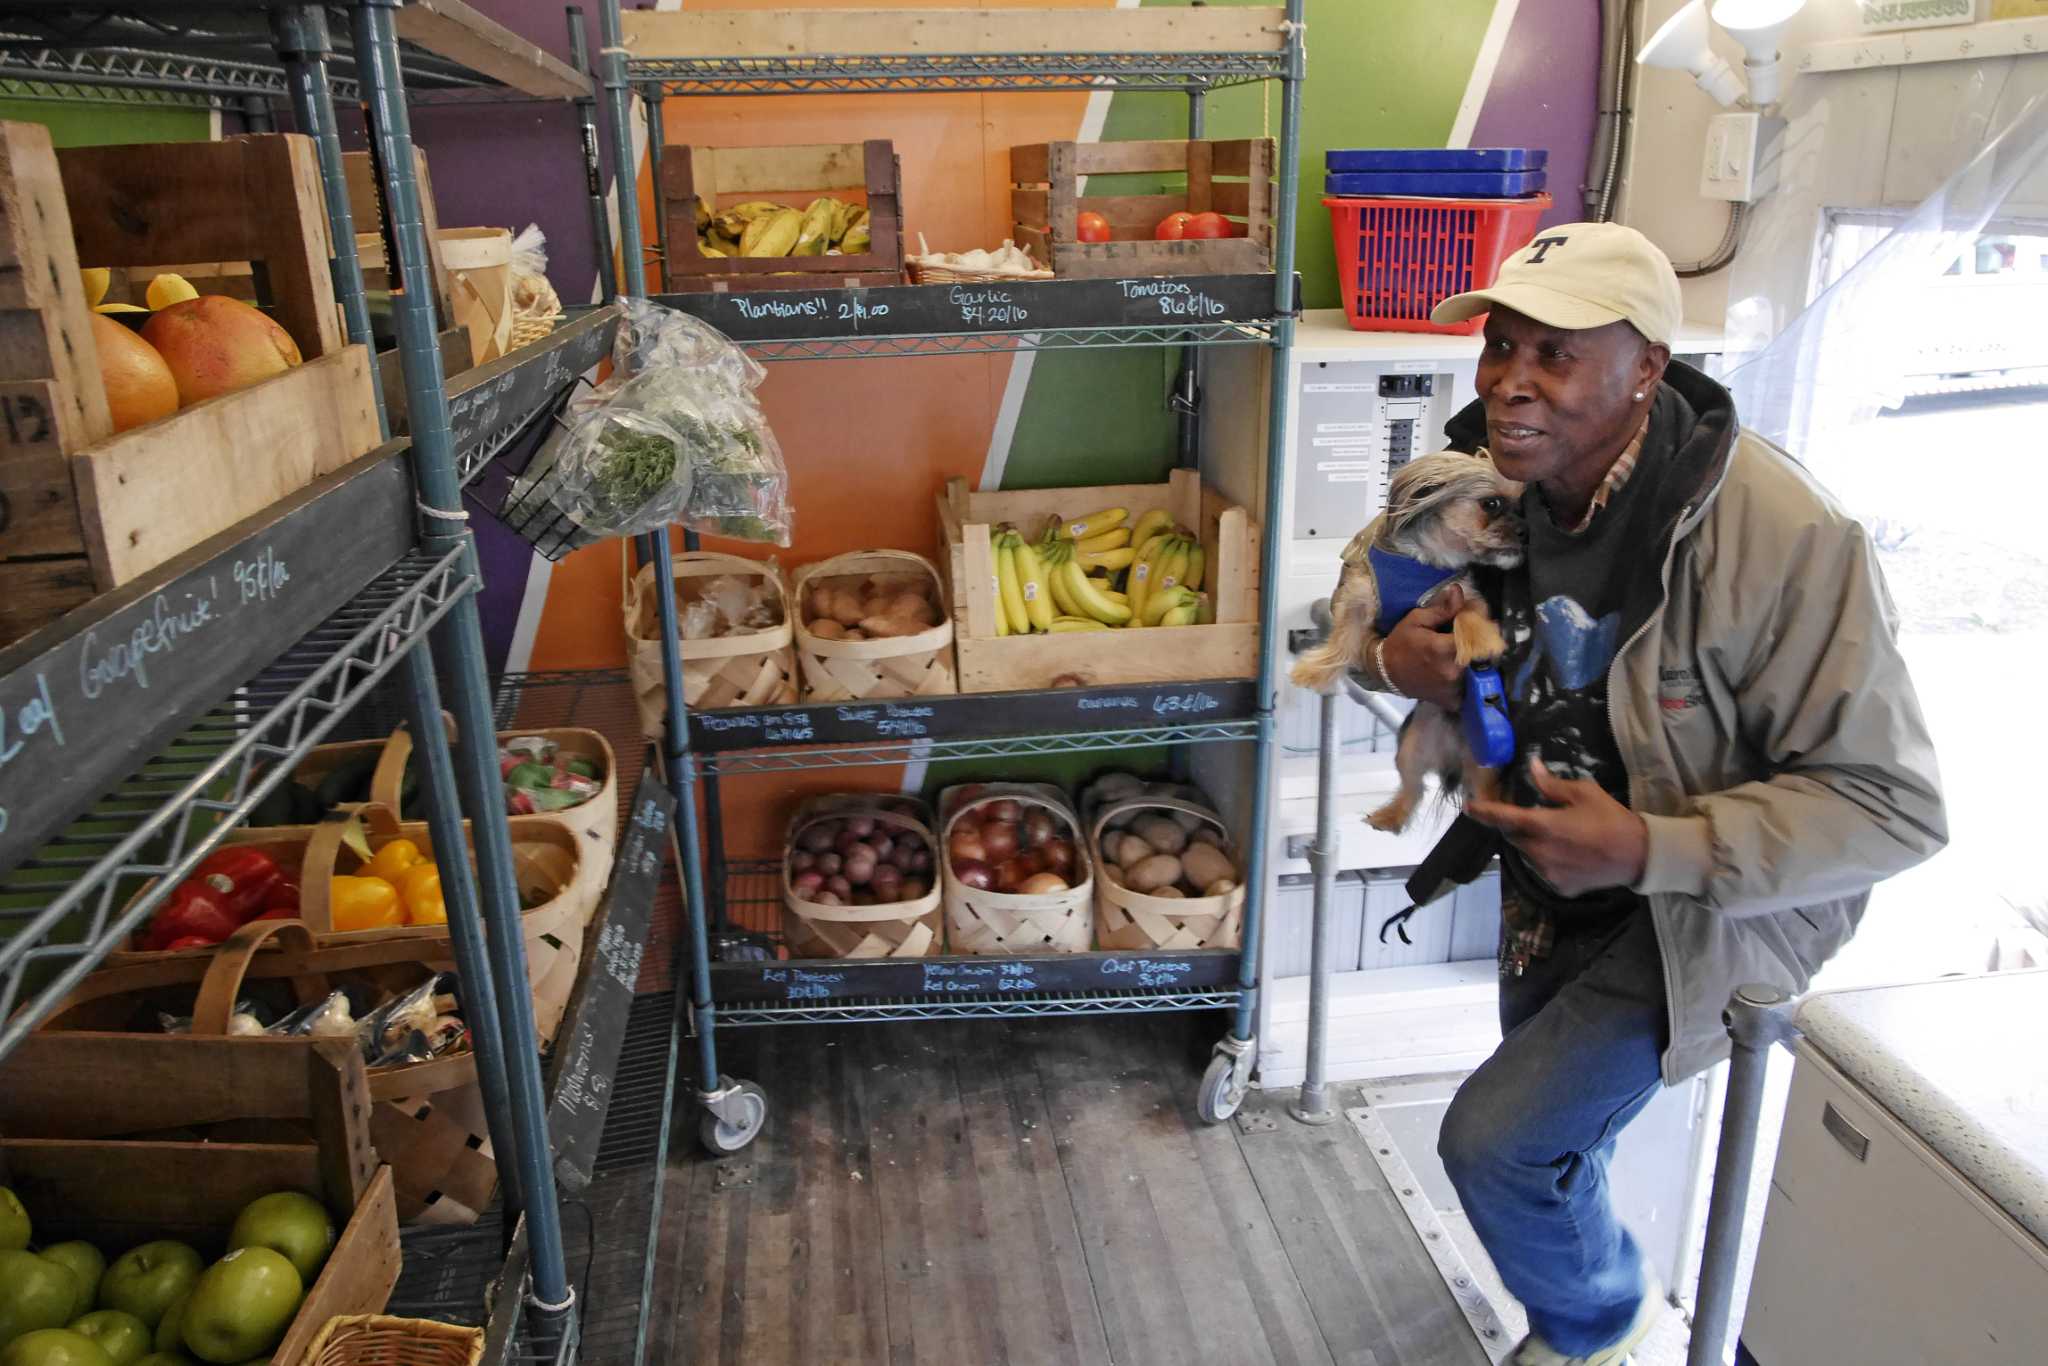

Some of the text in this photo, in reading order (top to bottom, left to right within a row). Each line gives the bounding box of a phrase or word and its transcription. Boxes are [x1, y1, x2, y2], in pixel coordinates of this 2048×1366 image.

[1525, 236, 1569, 264] T
[950, 285, 1012, 306] Garlic
[1115, 280, 1192, 298] Tomatoes
[961, 304, 1028, 325] $4.20/lb
